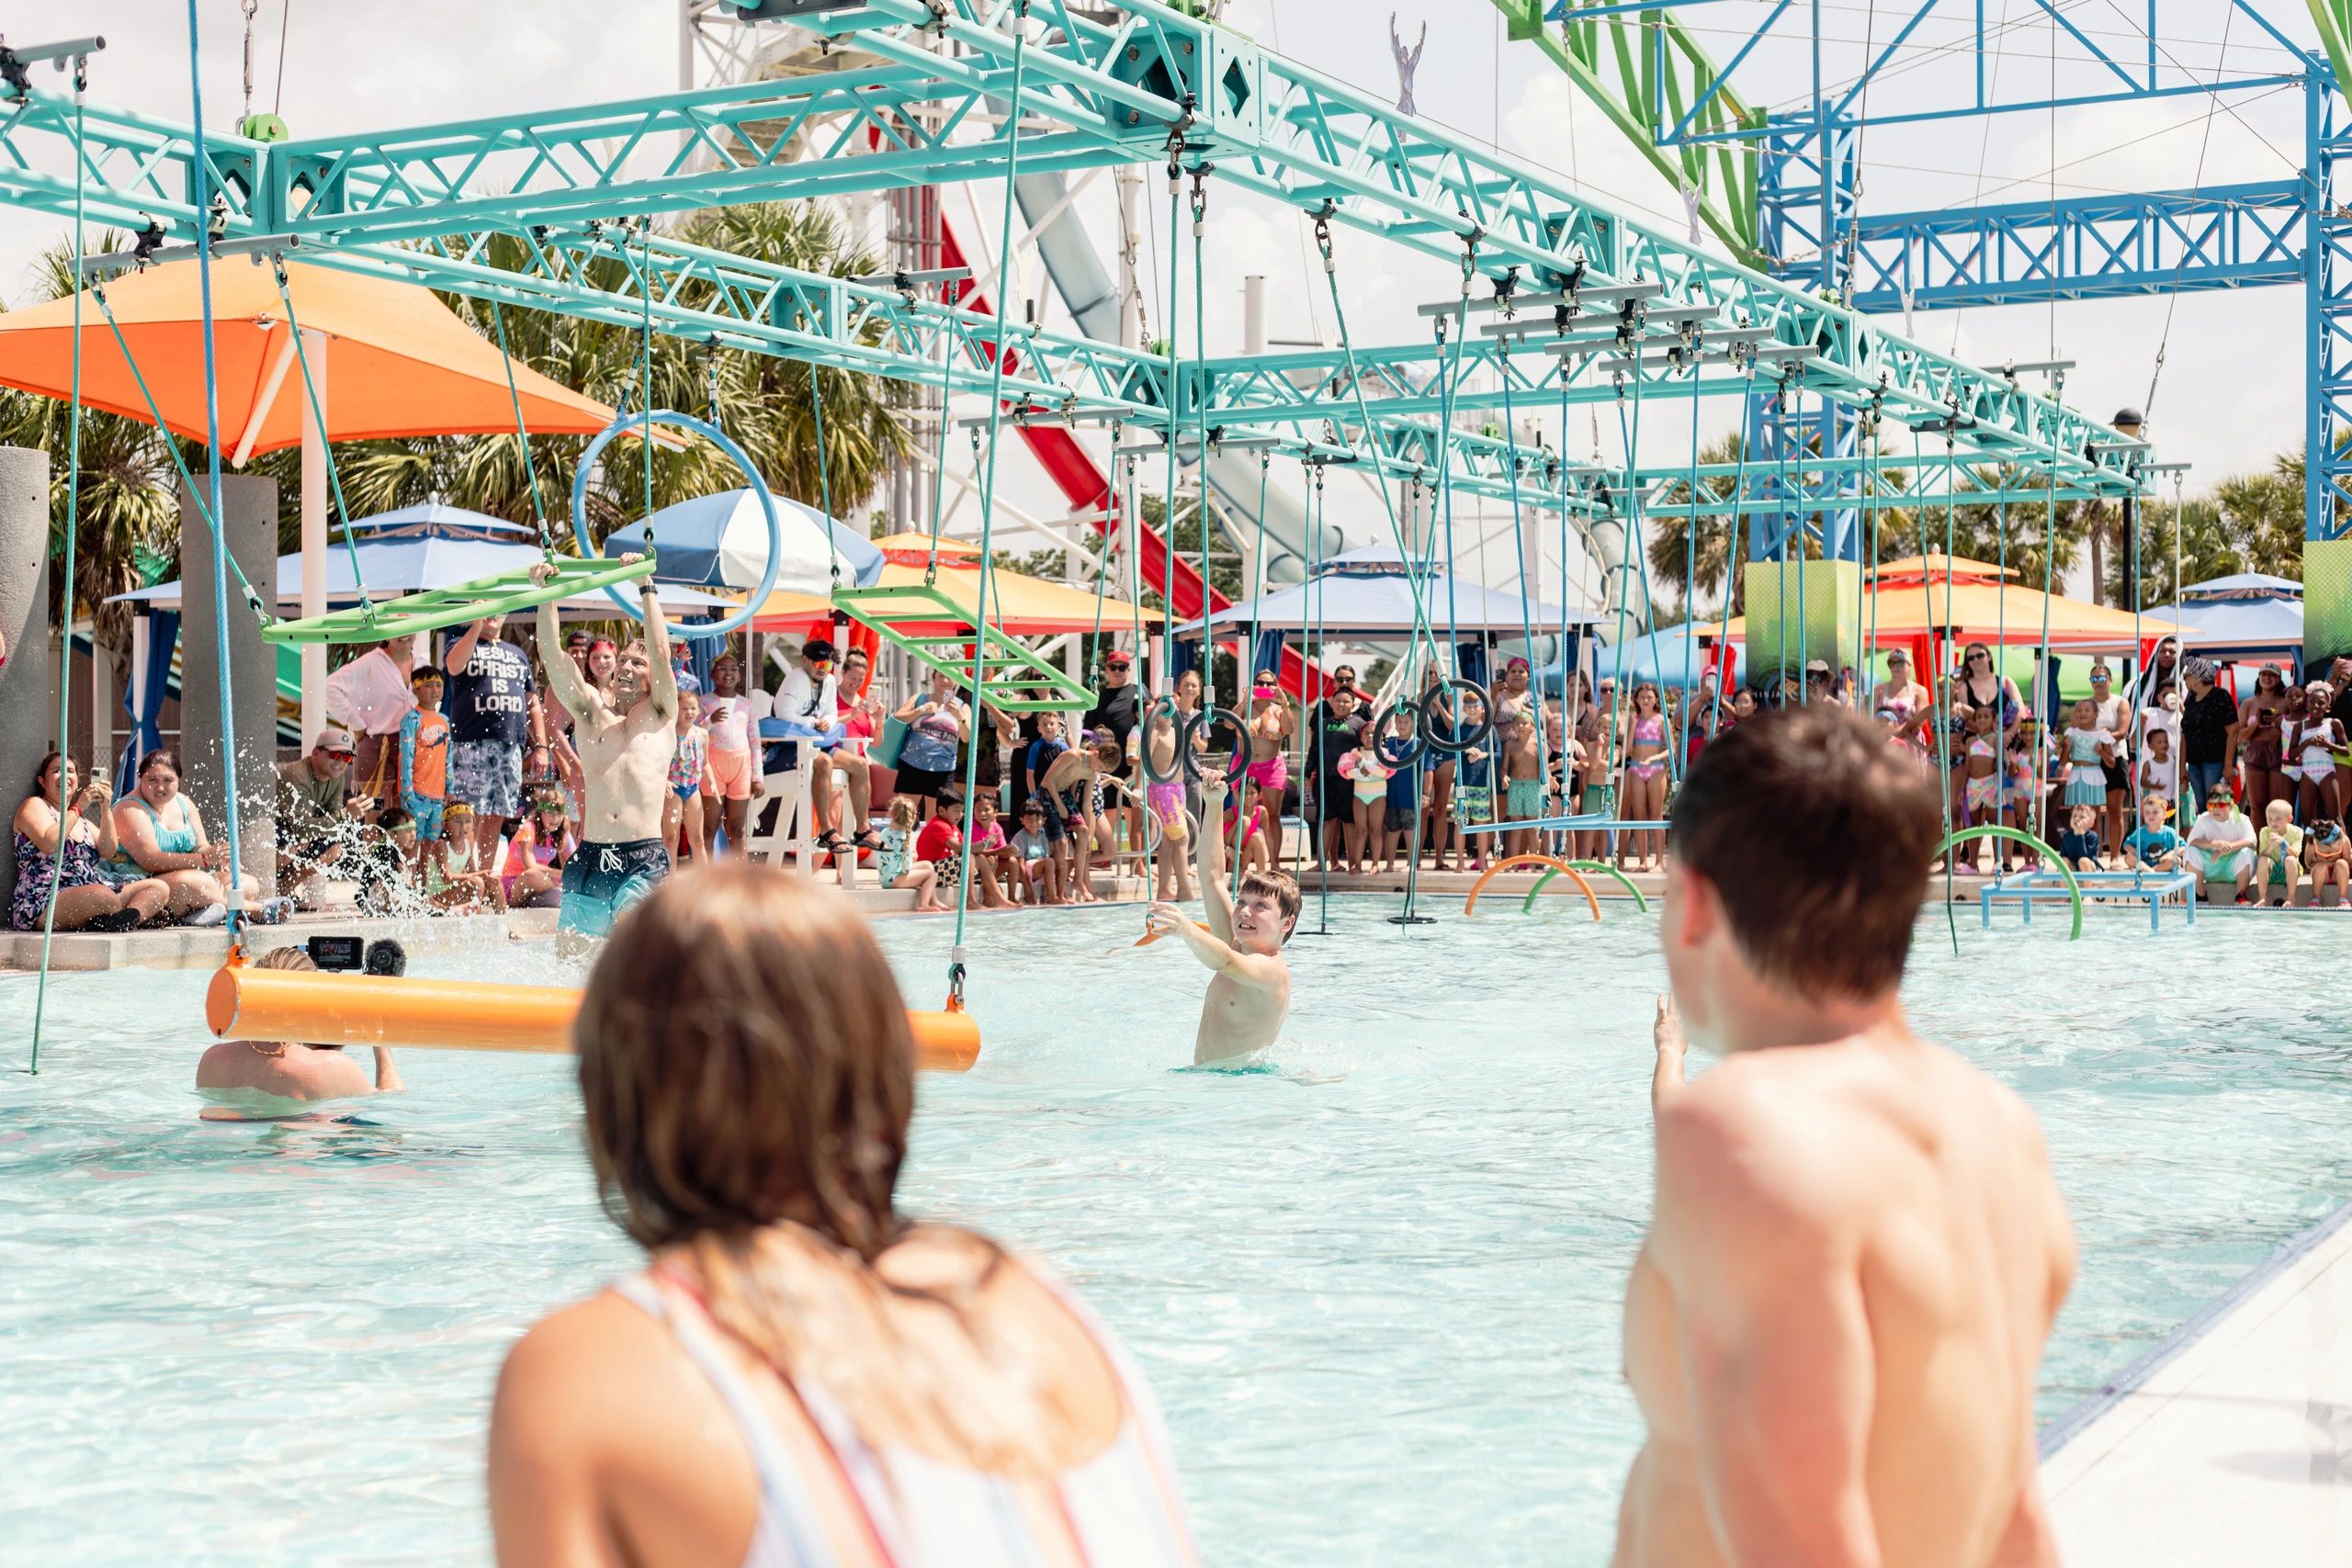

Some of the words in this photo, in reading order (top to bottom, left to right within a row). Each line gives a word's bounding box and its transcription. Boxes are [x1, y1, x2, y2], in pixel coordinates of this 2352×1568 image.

[473, 646, 520, 663] JESUS
[467, 660, 527, 680] CHRIST
[492, 678, 509, 694] IS
[475, 695, 523, 713] LORD
